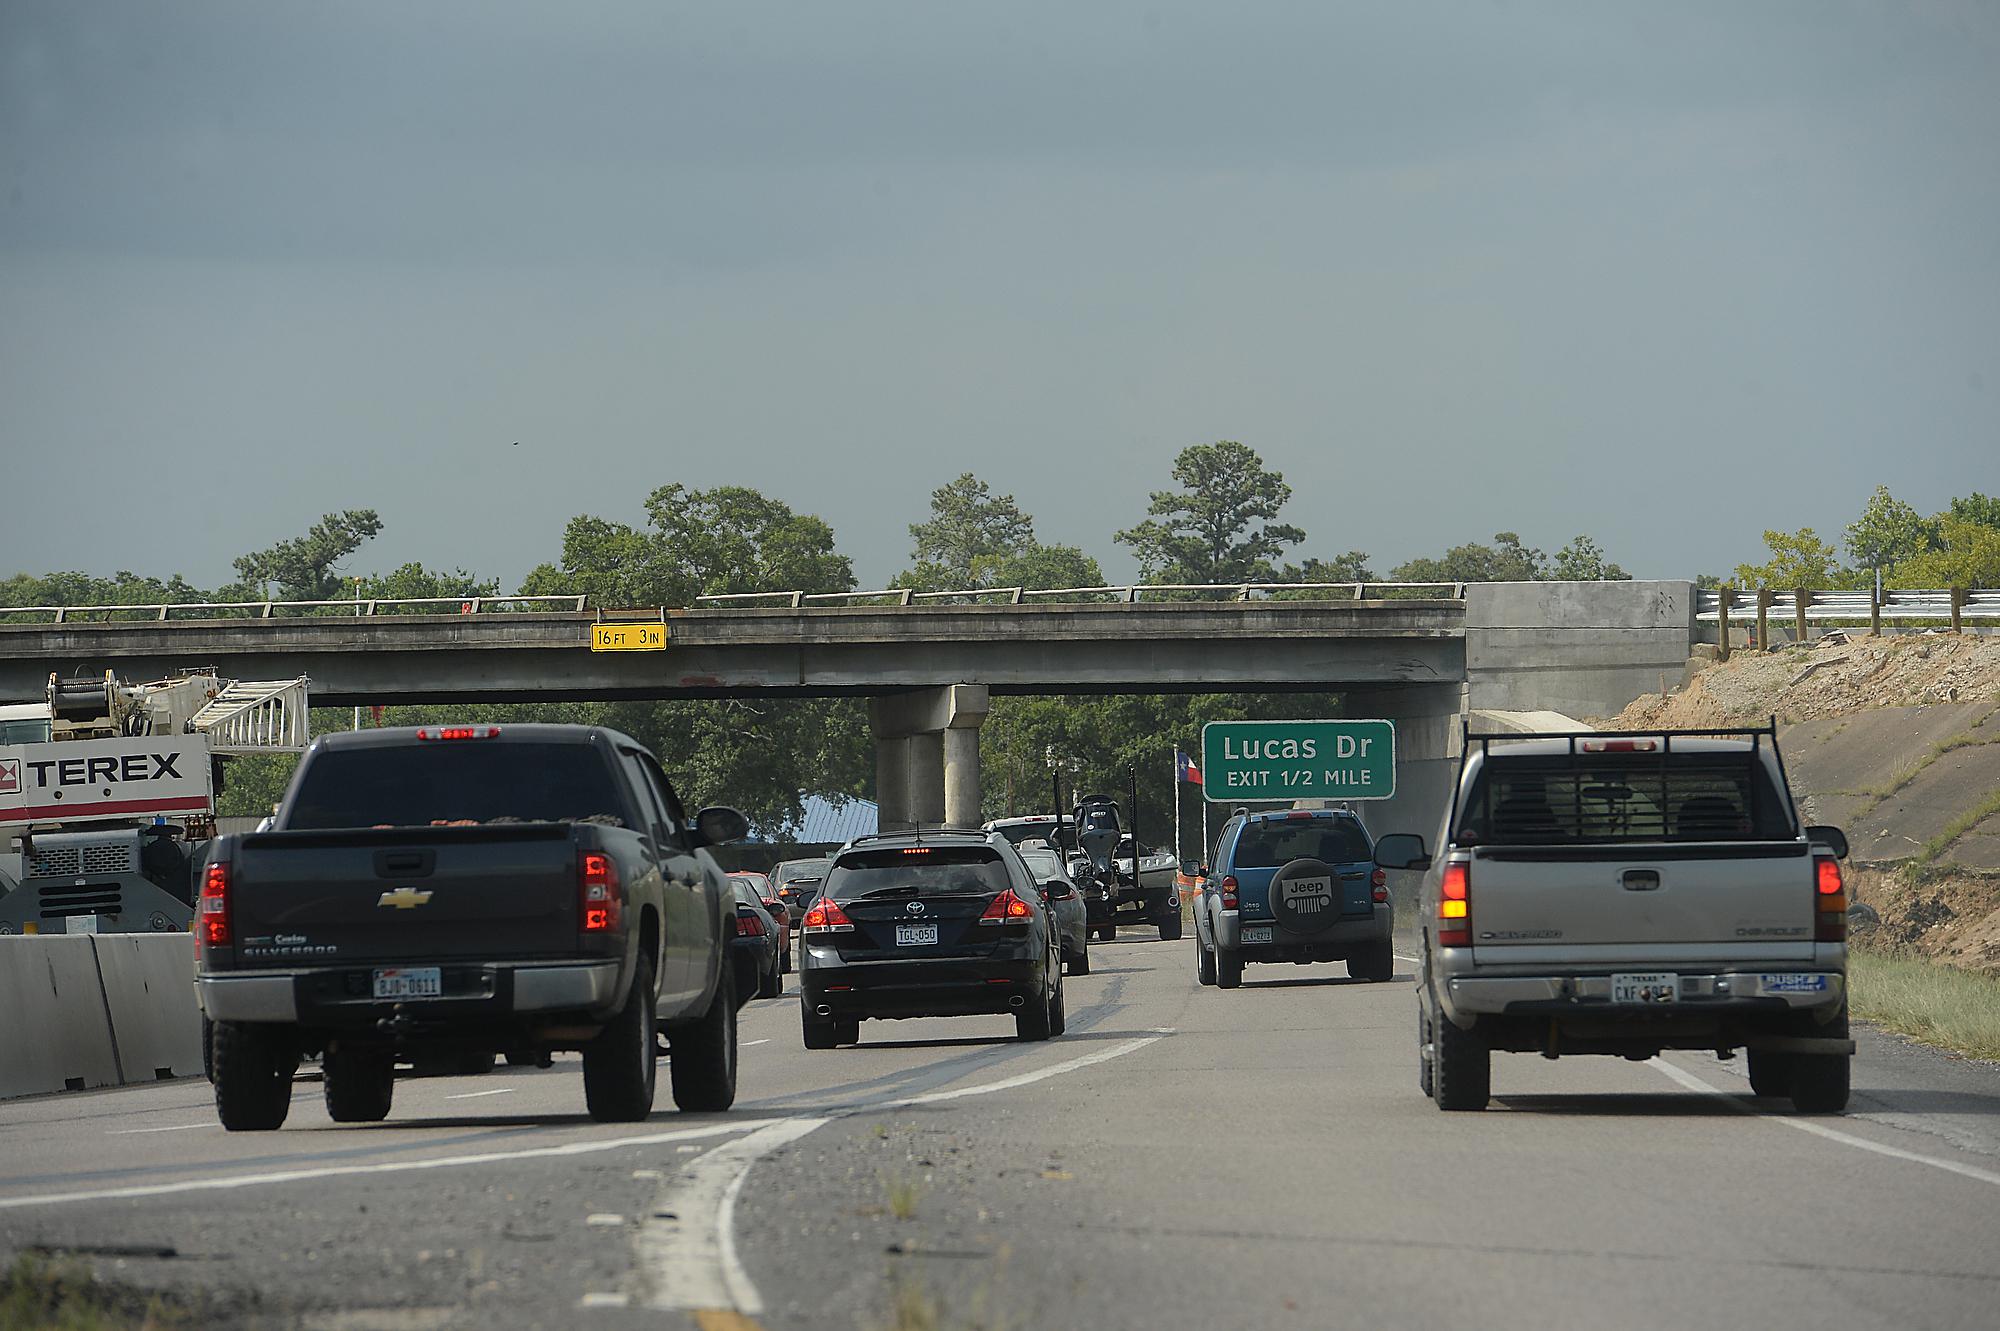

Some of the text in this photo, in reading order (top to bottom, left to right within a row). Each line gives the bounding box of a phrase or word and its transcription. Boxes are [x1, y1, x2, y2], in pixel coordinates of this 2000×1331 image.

[598, 629, 659, 645] 16 FT 3 IN
[1224, 735, 1373, 760] Lucas Dr
[26, 752, 183, 788] TEREX
[1227, 769, 1372, 787] EXIT 1/2 MILE
[1290, 881, 1324, 894] Jeep
